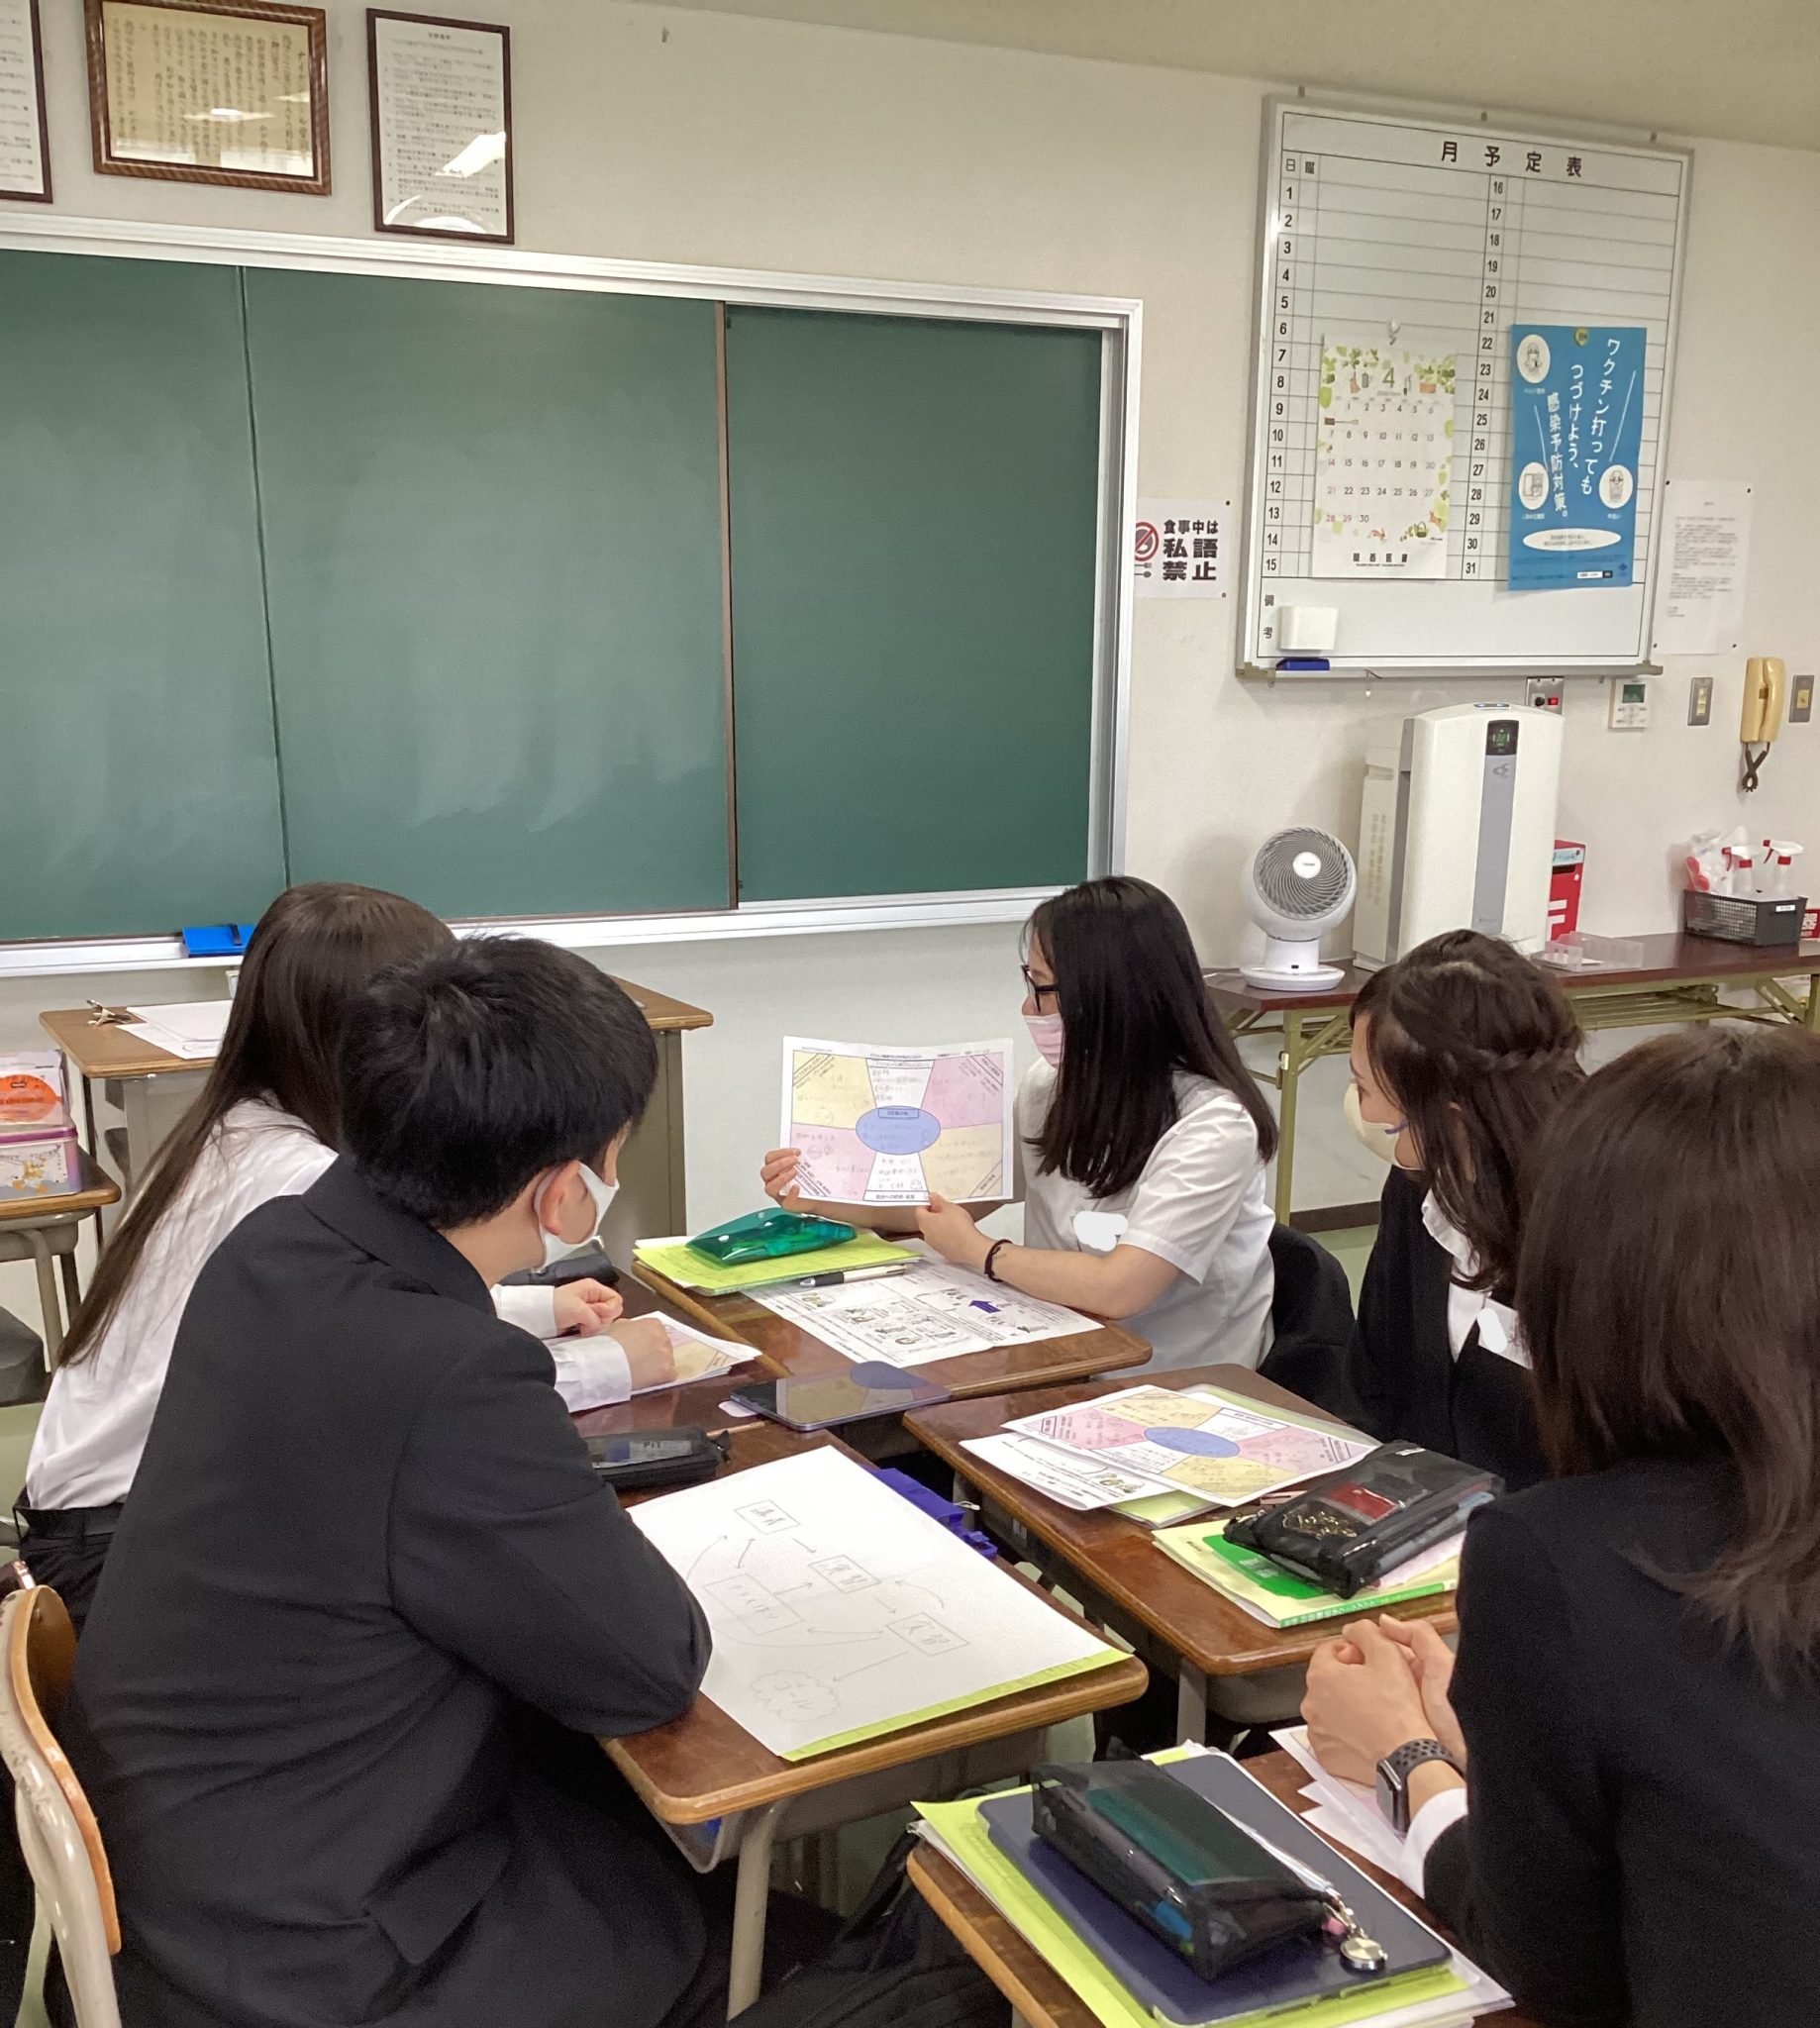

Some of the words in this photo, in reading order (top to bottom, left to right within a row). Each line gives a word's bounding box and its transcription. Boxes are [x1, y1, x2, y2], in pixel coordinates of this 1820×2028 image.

[1285, 158, 1296, 172] 日
[1441, 141, 1582, 177] 月予定表
[1286, 186, 1292, 200] 1
[1493, 181, 1503, 194] 16
[1284, 214, 1293, 228] 2
[1491, 208, 1502, 221] 17
[1489, 234, 1500, 247] 18
[1283, 241, 1291, 254] 3
[1487, 259, 1498, 273] 19
[1282, 268, 1289, 281] 4
[1486, 285, 1497, 298] 20
[1280, 295, 1289, 309] 5
[1483, 311, 1494, 324] 21
[1279, 322, 1287, 336] 6
[1481, 338, 1493, 351] 22
[1278, 349, 1286, 362] 7
[1479, 363, 1491, 376] 23
[1276, 375, 1284, 388] 8
[1382, 366, 1395, 389] 4
[1478, 388, 1489, 401] 24
[1275, 402, 1283, 416] 9
[1476, 414, 1488, 426] 25
[1567, 364, 1584, 468] つづけよう、
[1580, 338, 1621, 495] ワクチン打っても
[1271, 429, 1284, 442] 10
[1474, 439, 1486, 451] 26
[1271, 456, 1282, 467] 11
[1472, 464, 1484, 476] 27
[1269, 480, 1281, 494] 12
[1470, 488, 1482, 500] 28
[1268, 507, 1280, 520] 13
[1468, 513, 1480, 525] 29
[1163, 519, 1218, 535] 食事中は
[1266, 533, 1278, 546] 14
[1466, 538, 1478, 550] 30
[1163, 538, 1218, 558] 私語
[1163, 560, 1216, 581] 禁止
[1265, 558, 1277, 571] 15
[1466, 562, 1476, 574] 31
